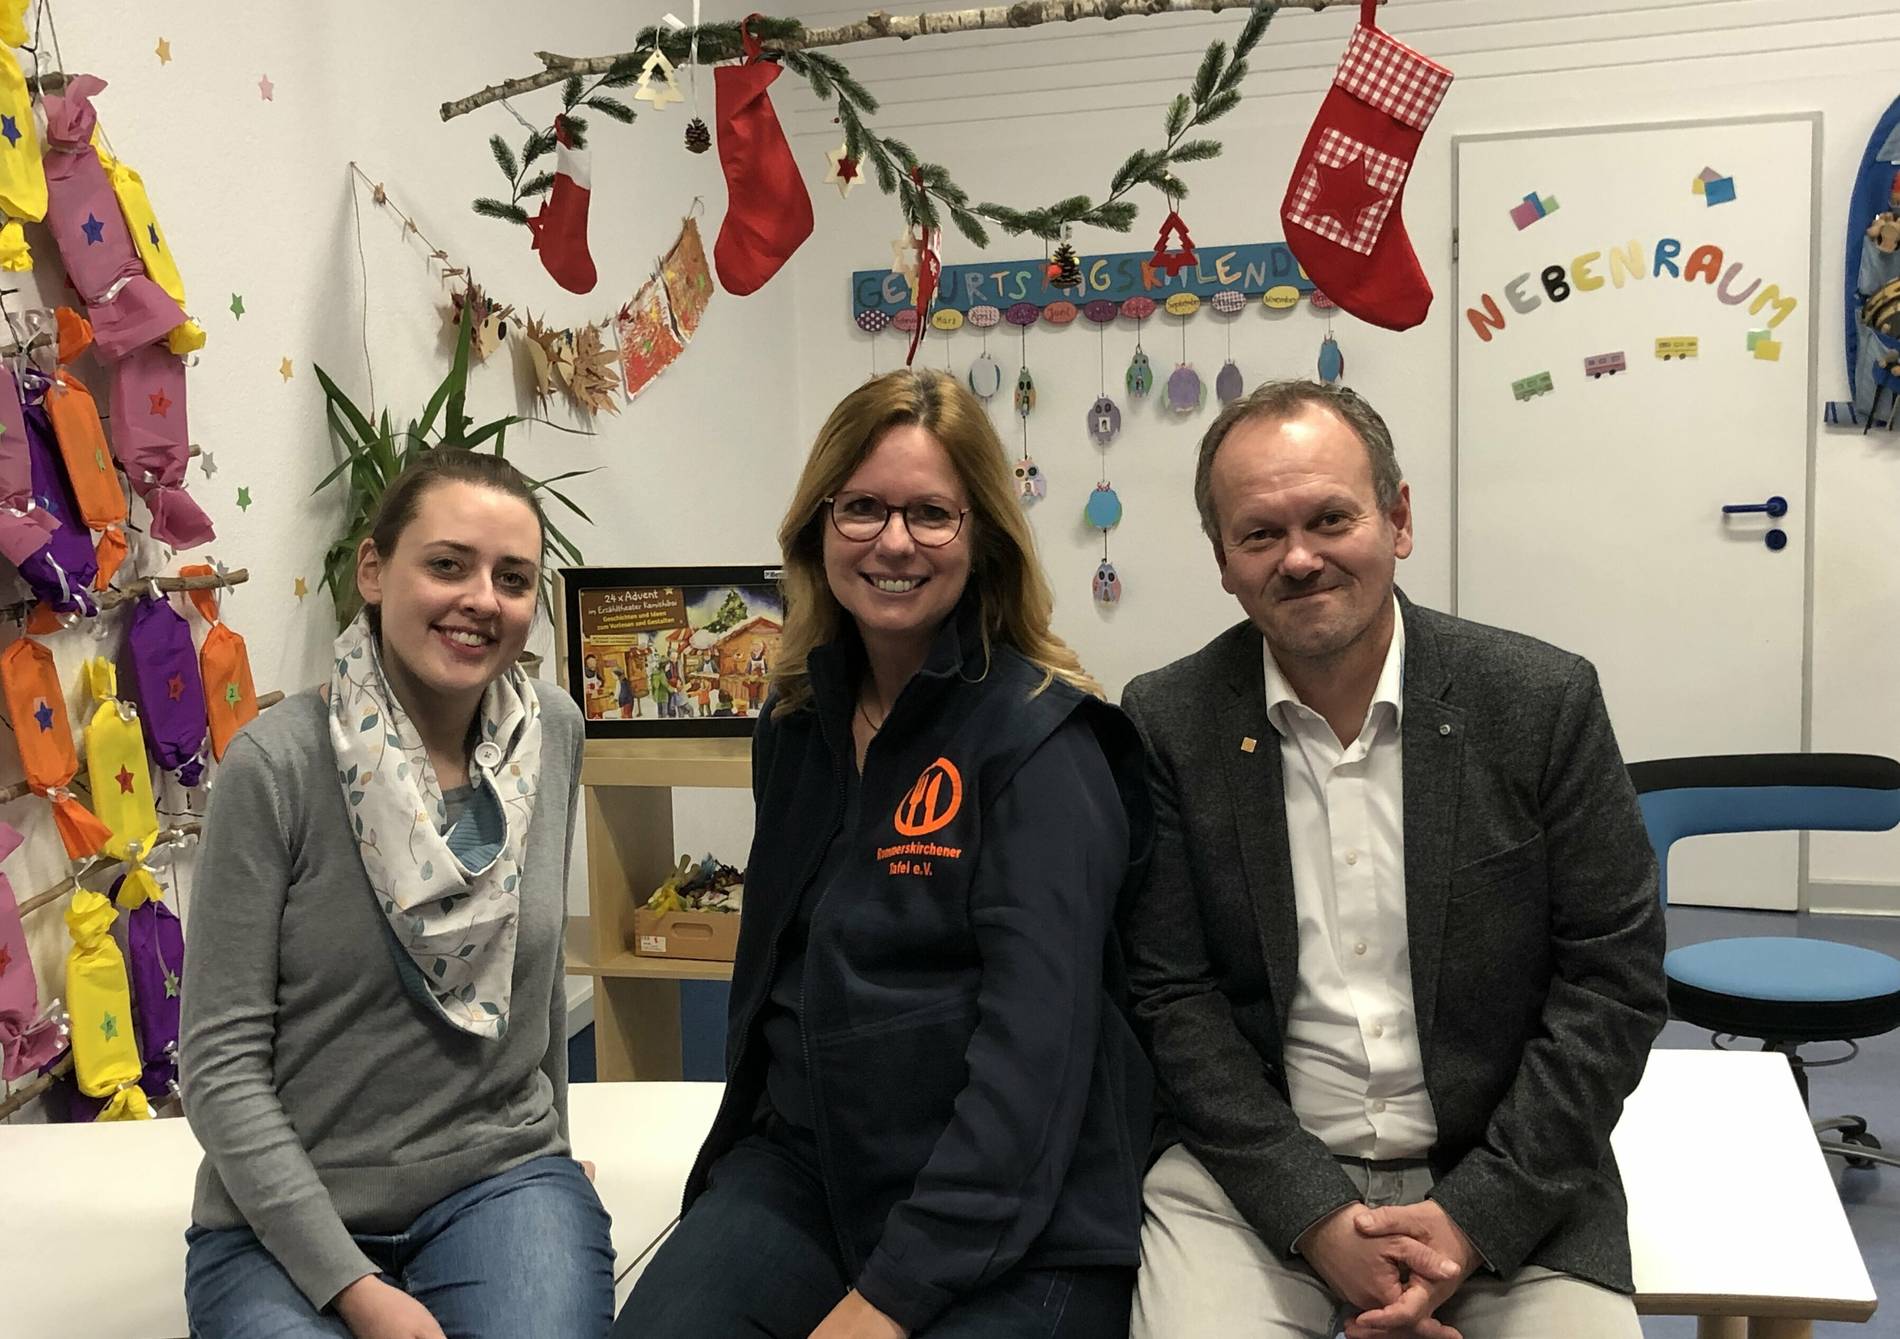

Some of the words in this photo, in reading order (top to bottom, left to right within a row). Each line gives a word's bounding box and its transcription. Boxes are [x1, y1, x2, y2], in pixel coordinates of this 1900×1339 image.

[1466, 238, 1797, 342] NEBENRAUM
[604, 594, 617, 603] 24
[625, 590, 658, 602] Advent
[603, 614, 638, 622] Geschichten
[638, 611, 650, 619] und
[647, 617, 675, 625] Gestalten
[912, 861, 933, 876] e.V.
